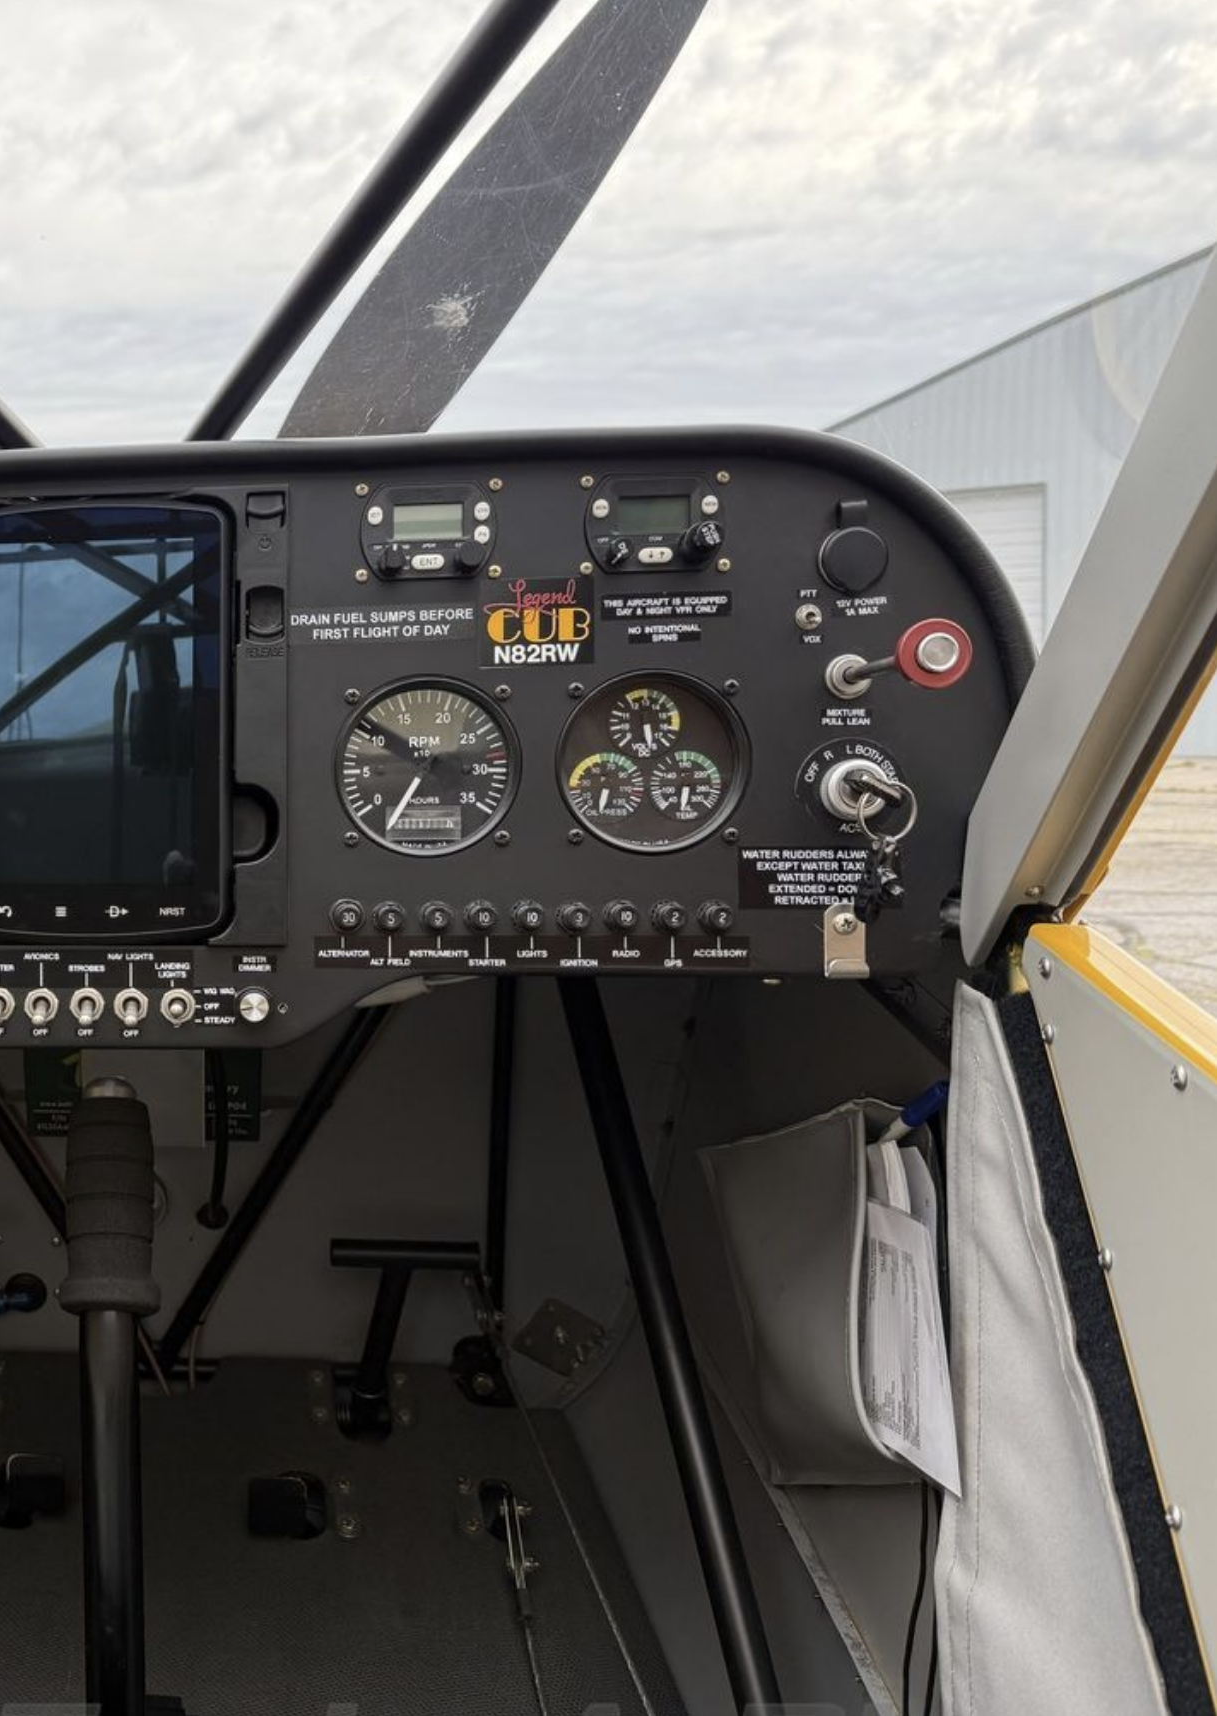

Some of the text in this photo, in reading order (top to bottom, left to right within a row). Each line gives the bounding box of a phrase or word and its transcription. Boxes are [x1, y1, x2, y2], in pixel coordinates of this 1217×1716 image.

[419, 557, 438, 567] ENT
[800, 589, 818, 598] PTT
[603, 595, 728, 608] THIS AIRCRAFT IS EQUIPPED
[836, 596, 887, 608] 12V POWER
[615, 608, 633, 616] DAY
[645, 606, 672, 615] NIGHT
[674, 606, 693, 614] VFR
[694, 604, 718, 614] ONLY
[844, 606, 879, 616] 1A MAX
[290, 607, 474, 627] DRAIN FUEL SUMPS BEFORE
[486, 606, 590, 644] CUB
[627, 624, 702, 635] NO INTENTIONAL
[312, 624, 452, 641] FIRST FLIGHT OF DAY
[651, 633, 679, 643] SPINS
[803, 635, 822, 644] VOX
[493, 643, 580, 665] N82RW
[435, 712, 451, 724] 20
[826, 709, 866, 717] MIXTURE
[398, 713, 411, 725] 15
[821, 717, 871, 726] PULL LEAN
[371, 736, 385, 746] 10
[408, 736, 440, 748] RPM
[460, 733, 476, 744] 25
[638, 749, 651, 758] DC
[822, 749, 834, 761] R
[846, 745, 853, 755] L
[855, 744, 884, 764] BOTH
[472, 764, 488, 775] 30
[804, 761, 819, 783] OFF
[409, 796, 440, 805] HOURS
[459, 792, 475, 804] 35
[676, 811, 699, 820] TEMP
[742, 850, 834, 859] WATER RUDDERS
[756, 861, 839, 871] EXCEPT WATER
[776, 873, 814, 882] WATER
[768, 883, 826, 893] EXTENDED
[774, 895, 843, 905] RETRACTED
[159, 907, 186, 917] NRST
[621, 911, 632, 923] 10
[342, 912, 356, 924] 30
[478, 911, 490, 924] 10
[526, 911, 538, 924] 10
[125, 953, 154, 961] LIGHTS
[318, 949, 371, 958] ALTERNATOR
[409, 949, 469, 958] INSTRUMENTS
[516, 949, 548, 959] LIGHTS
[612, 949, 641, 958] RADIO
[693, 949, 748, 958] ACCESSORY
[242, 956, 267, 964] INSTR
[370, 958, 411, 966] ALT FIELD
[468, 958, 506, 967] STARTER
[559, 958, 598, 968] IGNITION
[664, 958, 682, 968] GPS
[68, 964, 106, 973] STROBES
[154, 962, 191, 971] LANDING
[238, 964, 272, 973] DIMMER
[158, 970, 187, 979] LIGHTS
[219, 987, 236, 995] WAG
[203, 1002, 220, 1010] OFF
[203, 1016, 236, 1025] STEADY
[32, 1028, 49, 1037] OFF
[77, 1028, 94, 1037] OFF
[123, 1029, 140, 1038] OFF
